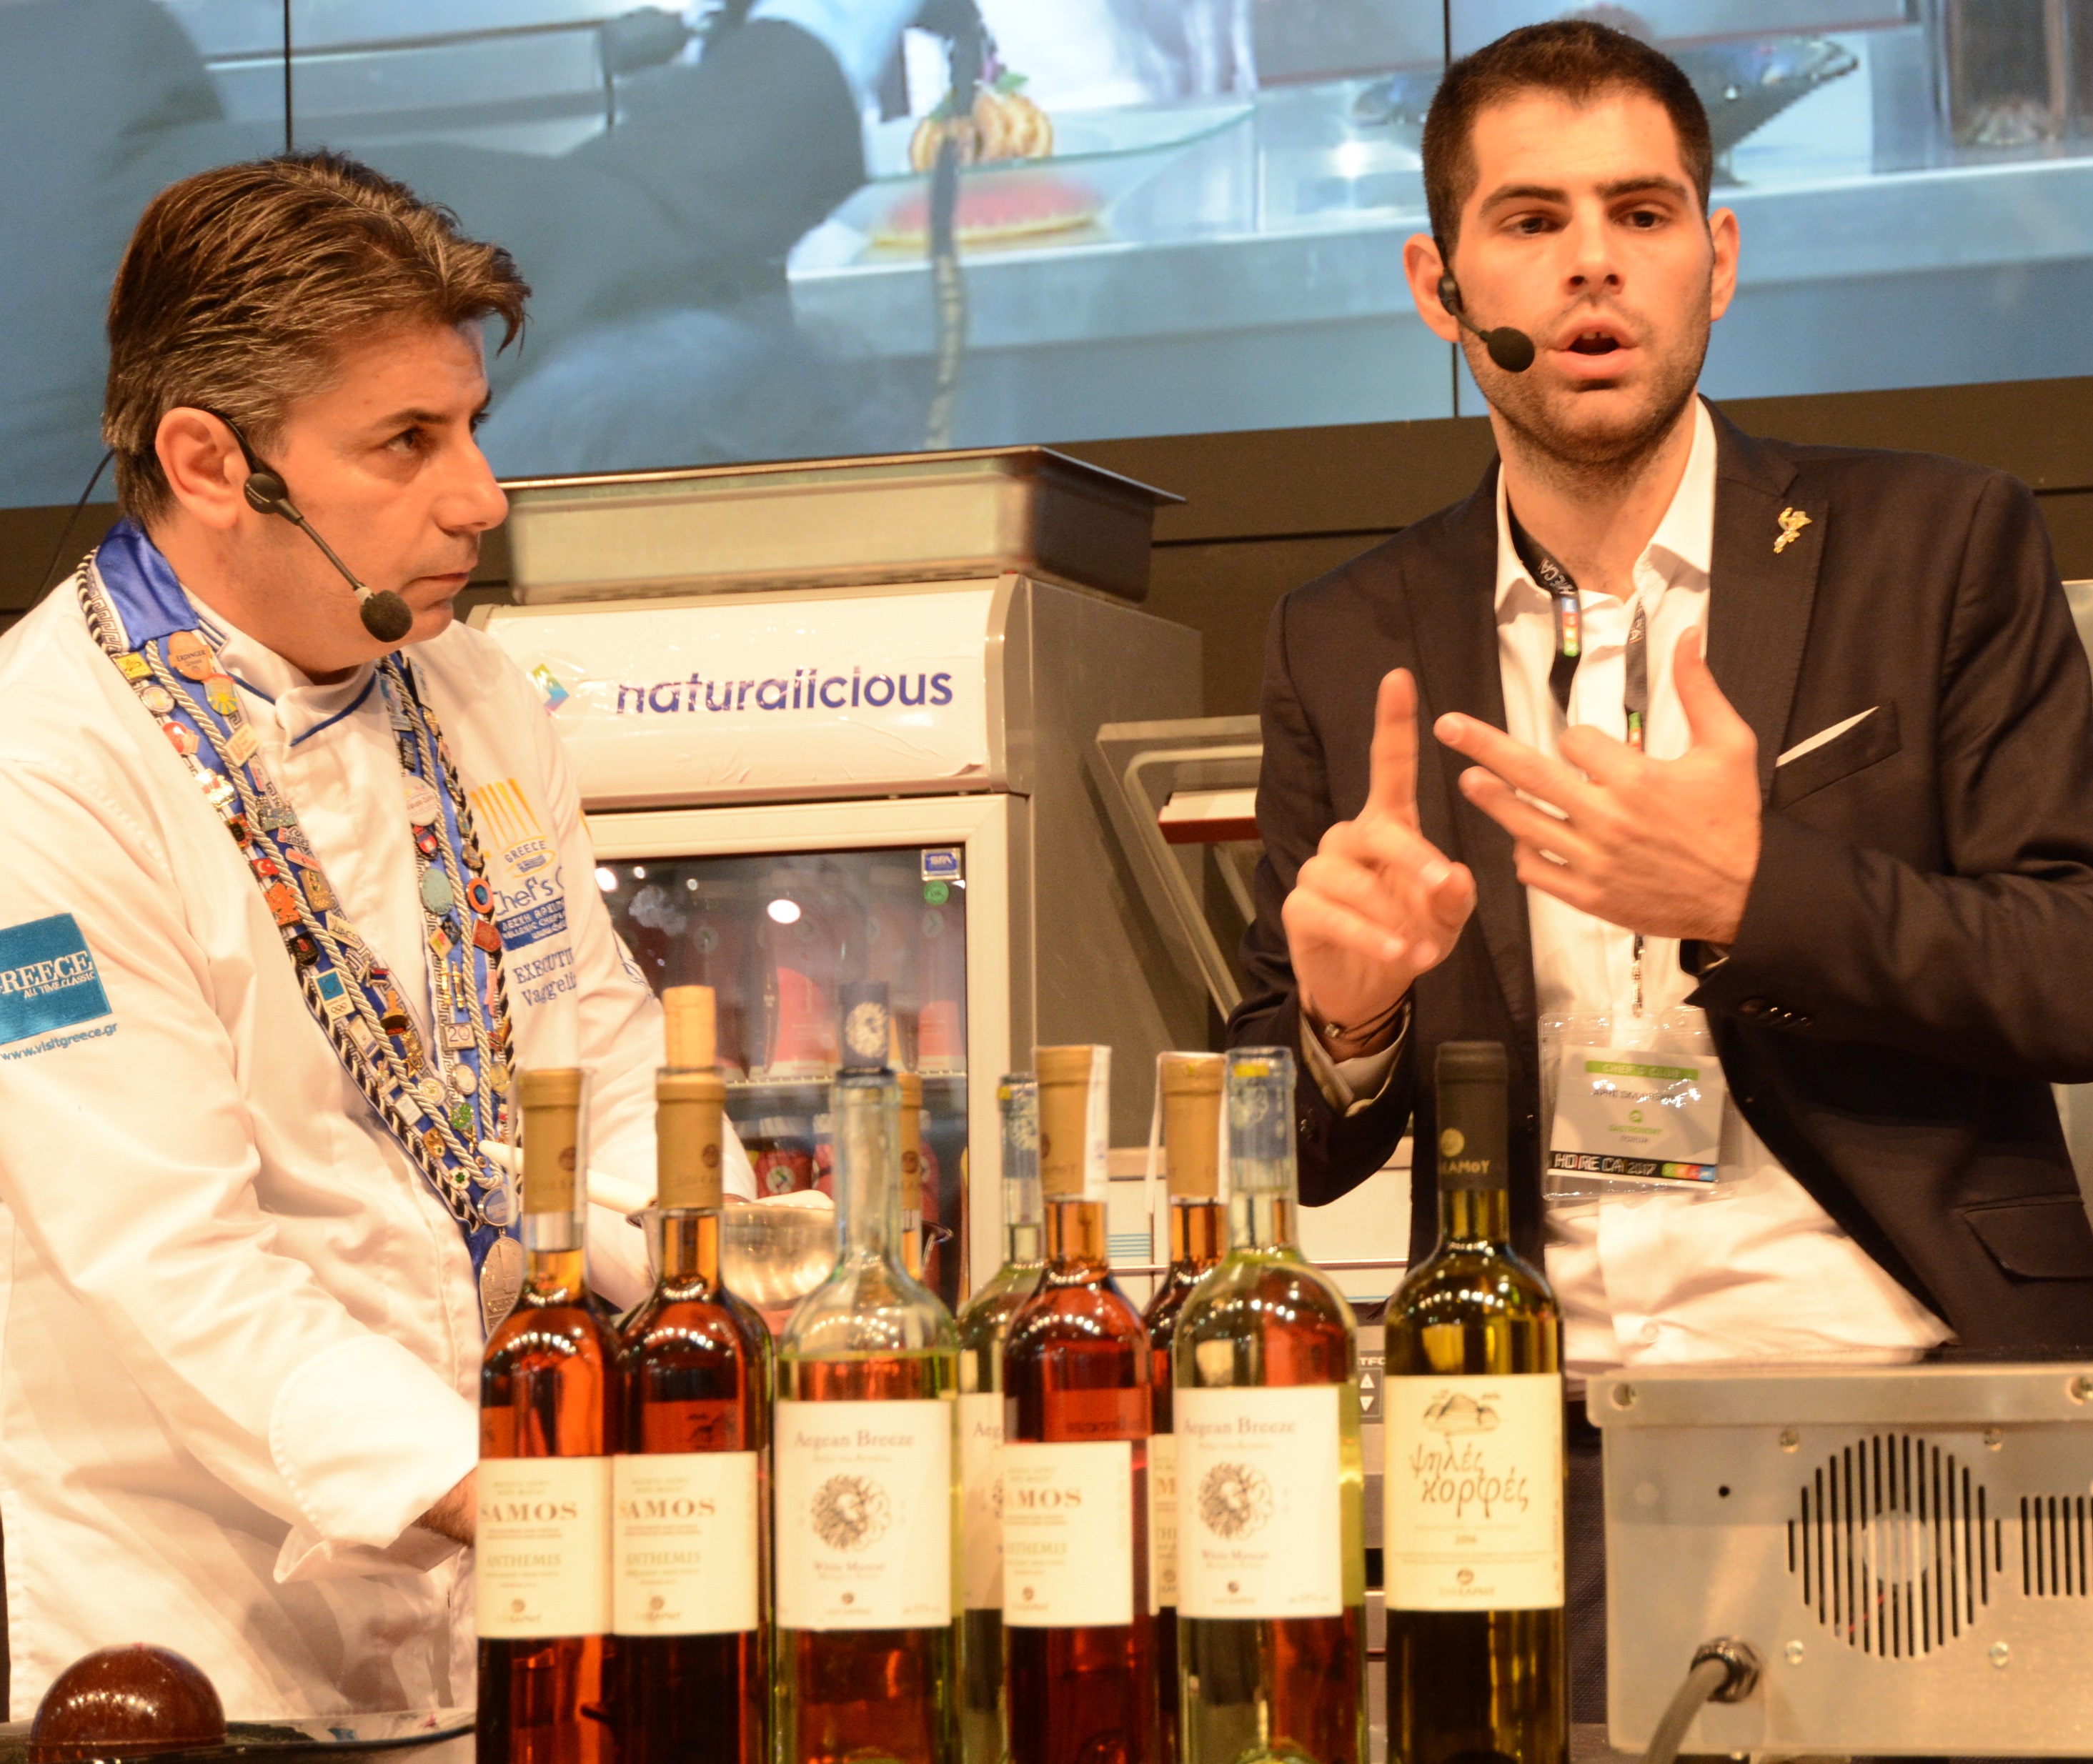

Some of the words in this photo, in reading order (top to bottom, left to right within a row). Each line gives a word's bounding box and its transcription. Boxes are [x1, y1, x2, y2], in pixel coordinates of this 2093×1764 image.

[616, 664, 953, 715] naturalicious
[504, 840, 547, 863] GREECE
[0, 950, 93, 995] REECE
[24, 988, 38, 999] ALL
[39, 982, 61, 994] TIME
[61, 972, 96, 987] CLASSIC
[1627, 1162, 1657, 1176] 2017
[1183, 1418, 1233, 1437] Aegean
[1238, 1417, 1297, 1435] Breeze
[793, 1431, 851, 1450] Aegean
[857, 1429, 915, 1447] Breeze
